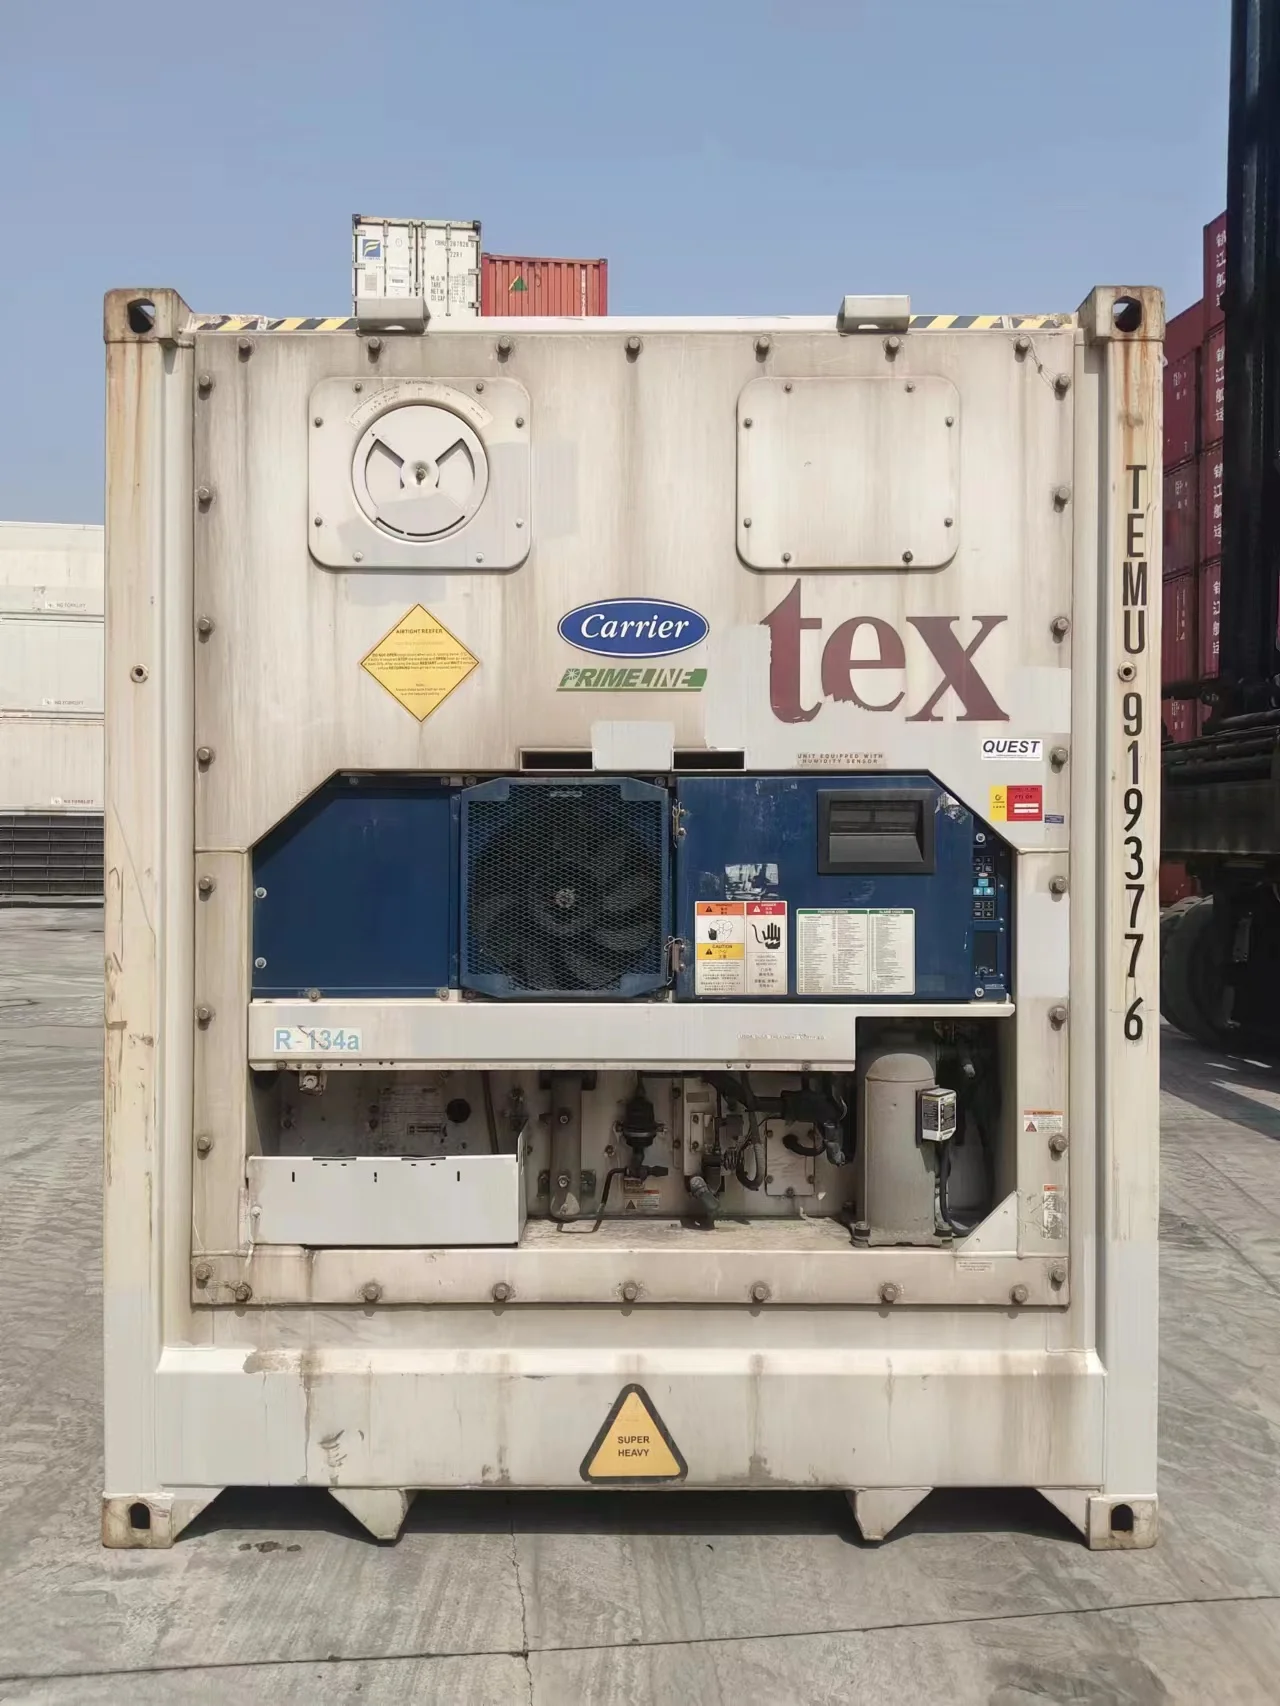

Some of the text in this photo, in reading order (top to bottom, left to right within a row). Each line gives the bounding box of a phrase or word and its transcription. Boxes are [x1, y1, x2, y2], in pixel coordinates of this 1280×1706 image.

[1122, 464, 1148, 654] TEMU
[580, 613, 690, 639] Carrier
[758, 578, 1010, 723] tex
[559, 668, 708, 688] PRIMELINE
[982, 740, 1041, 754] QUEST
[617, 1436, 650, 1444] SUPER
[617, 1449, 650, 1457] HEAVY
